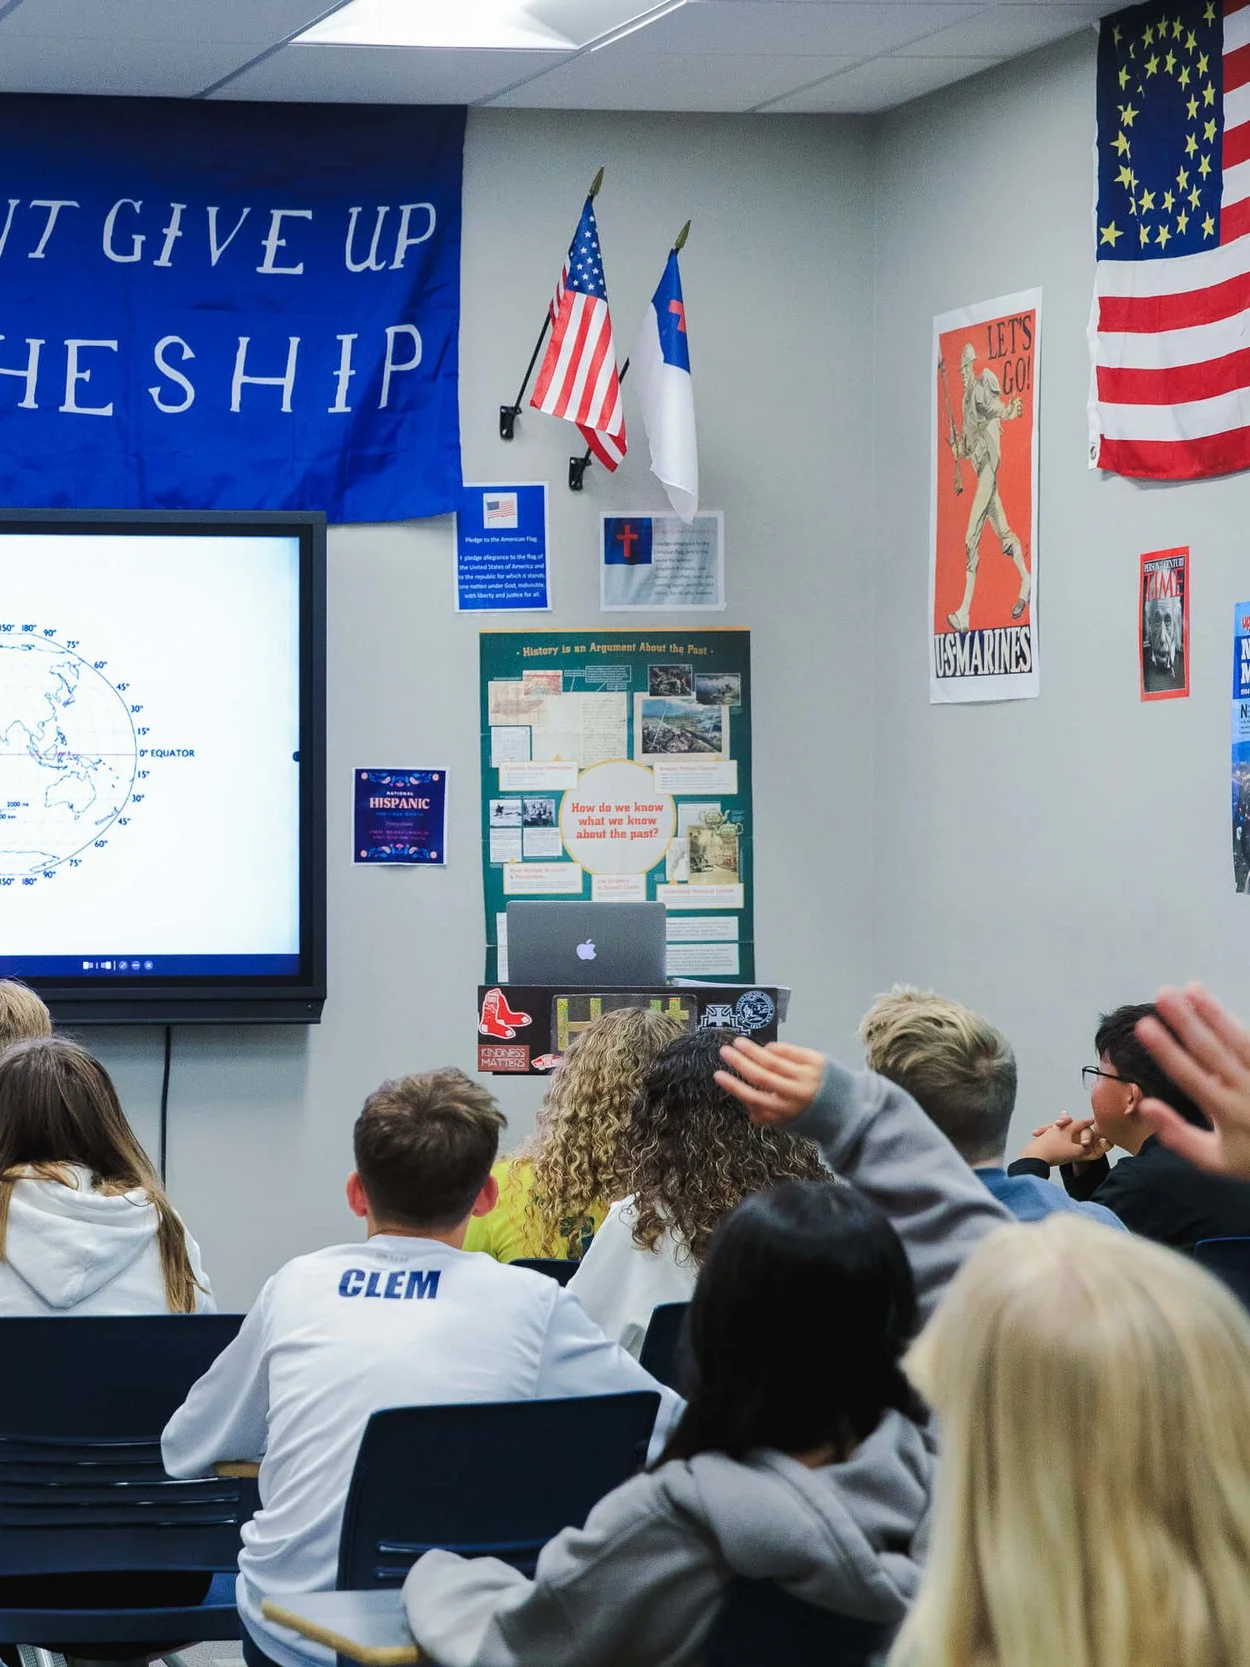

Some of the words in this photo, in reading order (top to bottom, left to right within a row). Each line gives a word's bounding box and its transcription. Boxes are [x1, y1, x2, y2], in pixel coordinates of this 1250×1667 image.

[101, 198, 314, 275] GIVE
[344, 201, 437, 272] UP
[987, 314, 1032, 360] LET'S
[148, 323, 423, 414] SHIP
[1002, 355, 1031, 396] GO!
[1144, 567, 1184, 601] TIME
[0, 623, 15, 632] 150°
[22, 623, 37, 632] 180°
[43, 629, 56, 637] 90°
[67, 640, 79, 649] 75°
[523, 646, 558, 657] History
[562, 644, 571, 653] is
[590, 642, 636, 653] Argument
[639, 643, 666, 653] About
[669, 645, 684, 653] the
[688, 646, 708, 655] Past
[94, 661, 107, 669] 60°
[150, 750, 195, 758] EQUATOR
[370, 797, 430, 809] HISPANIC
[571, 802, 596, 813] How
[599, 802, 611, 812] do
[634, 802, 663, 812] know
[118, 818, 131, 826] 45°
[578, 816, 605, 826] what
[627, 816, 656, 826] know
[576, 829, 607, 839] about
[610, 829, 626, 839] the
[630, 828, 659, 840] past?
[94, 840, 108, 848] 60°
[43, 871, 56, 879] 90°
[22, 878, 37, 886] 180°
[481, 1048, 525, 1058] KINDNESS
[481, 1058, 525, 1067] MATTERS
[338, 1268, 441, 1299] CLEM
